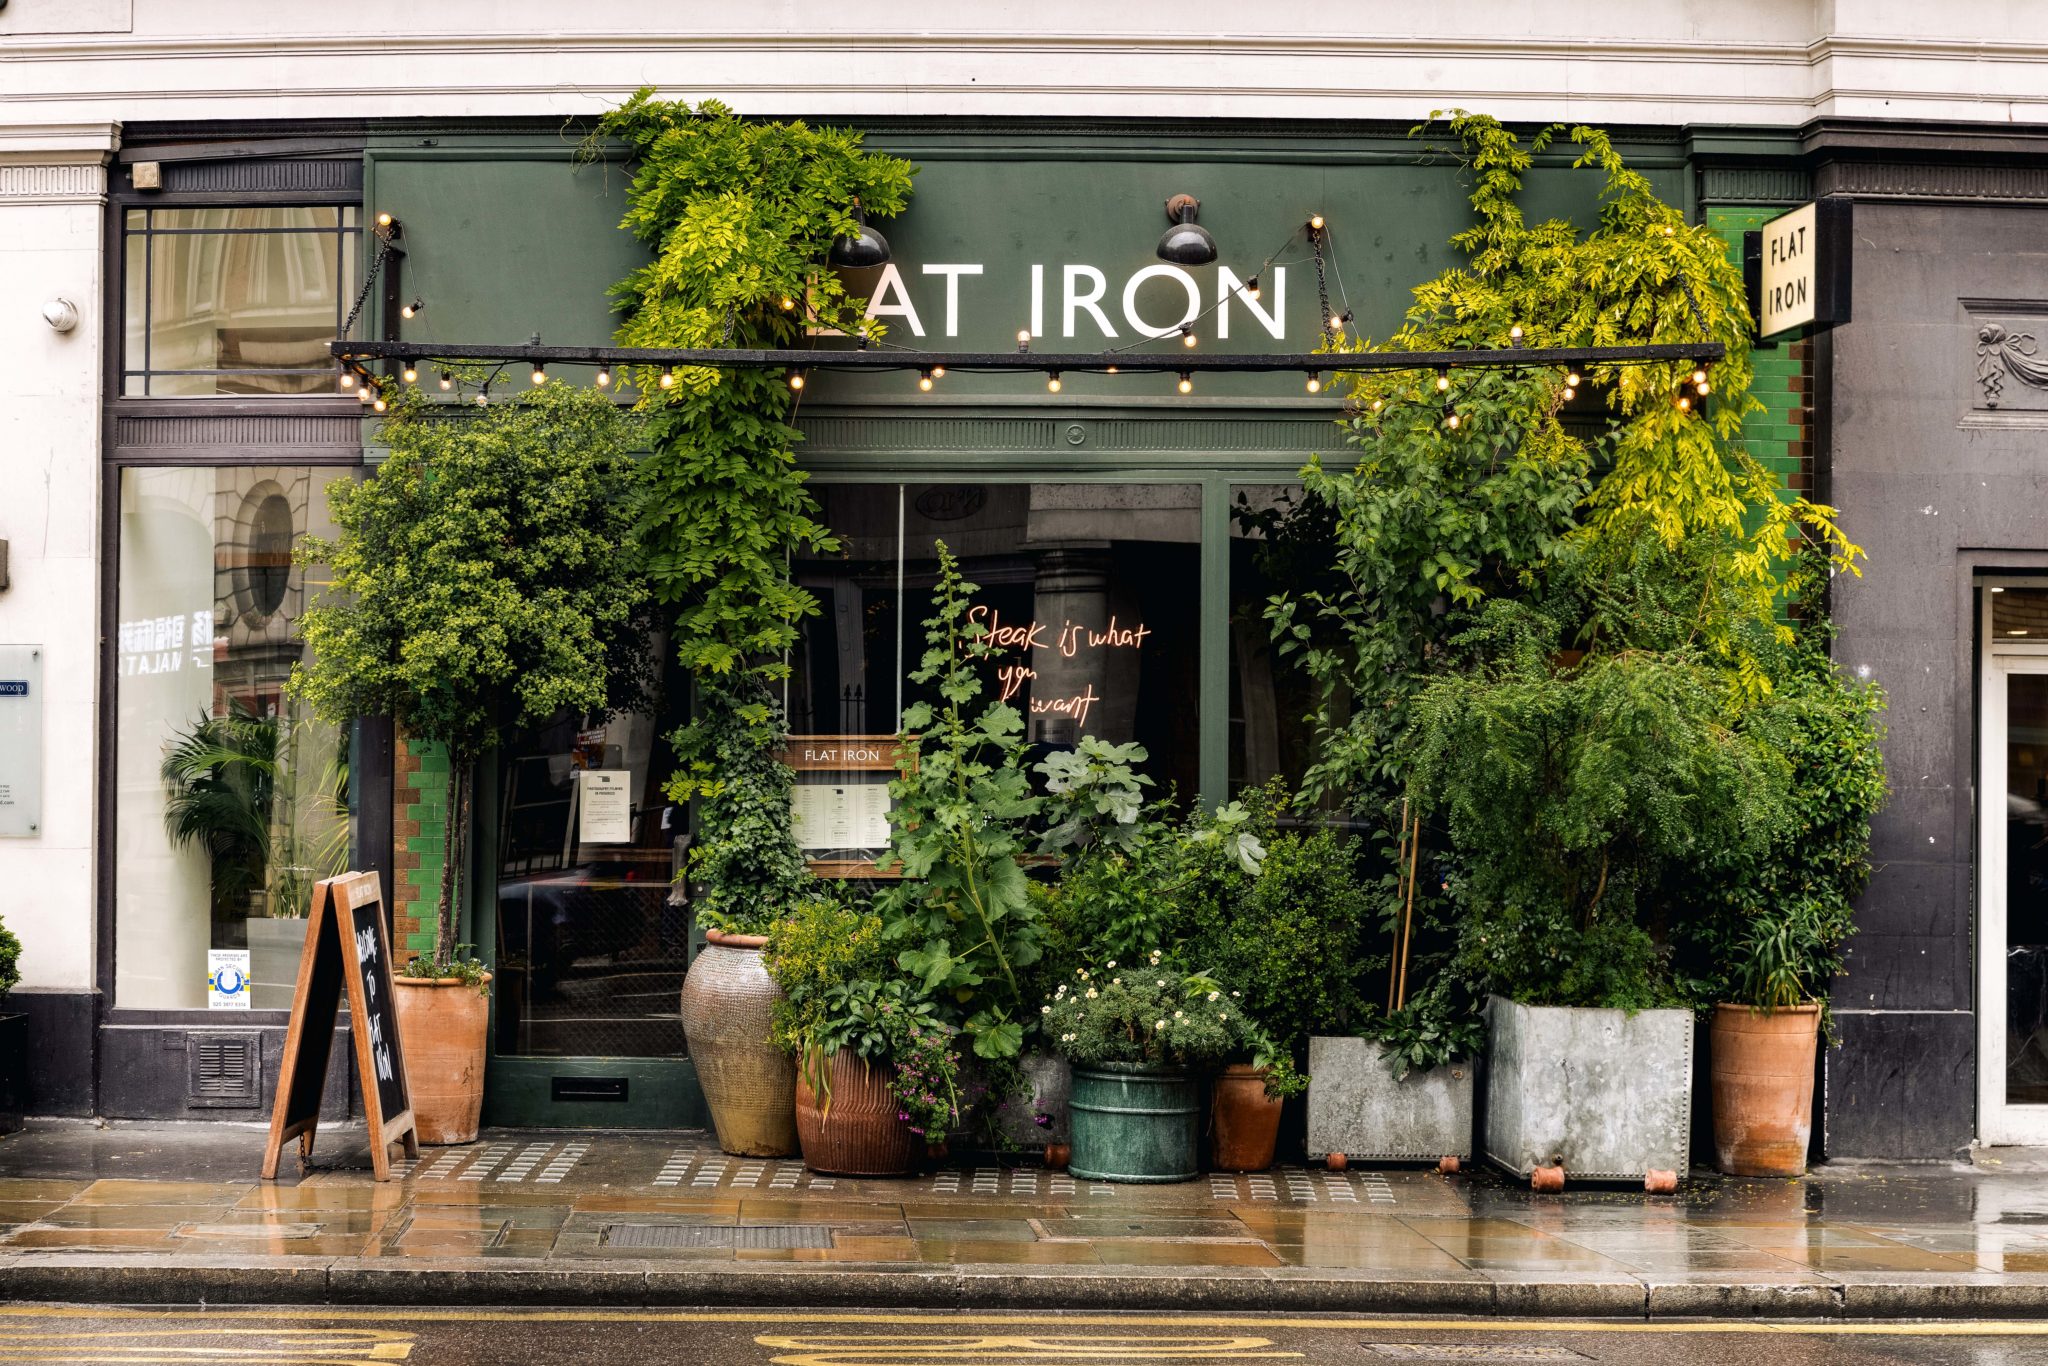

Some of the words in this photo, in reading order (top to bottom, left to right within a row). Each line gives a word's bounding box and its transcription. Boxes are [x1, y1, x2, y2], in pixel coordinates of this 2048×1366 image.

[1771, 226, 1806, 266] FLAT
[806, 263, 984, 338] LAT
[1031, 264, 1286, 340] IRON
[1769, 276, 1807, 315] IRON
[1059, 619, 1084, 657] is
[1089, 615, 1152, 649] what
[1031, 684, 1100, 728] want
[804, 749, 838, 761] FLAT
[843, 749, 880, 761] IRON
